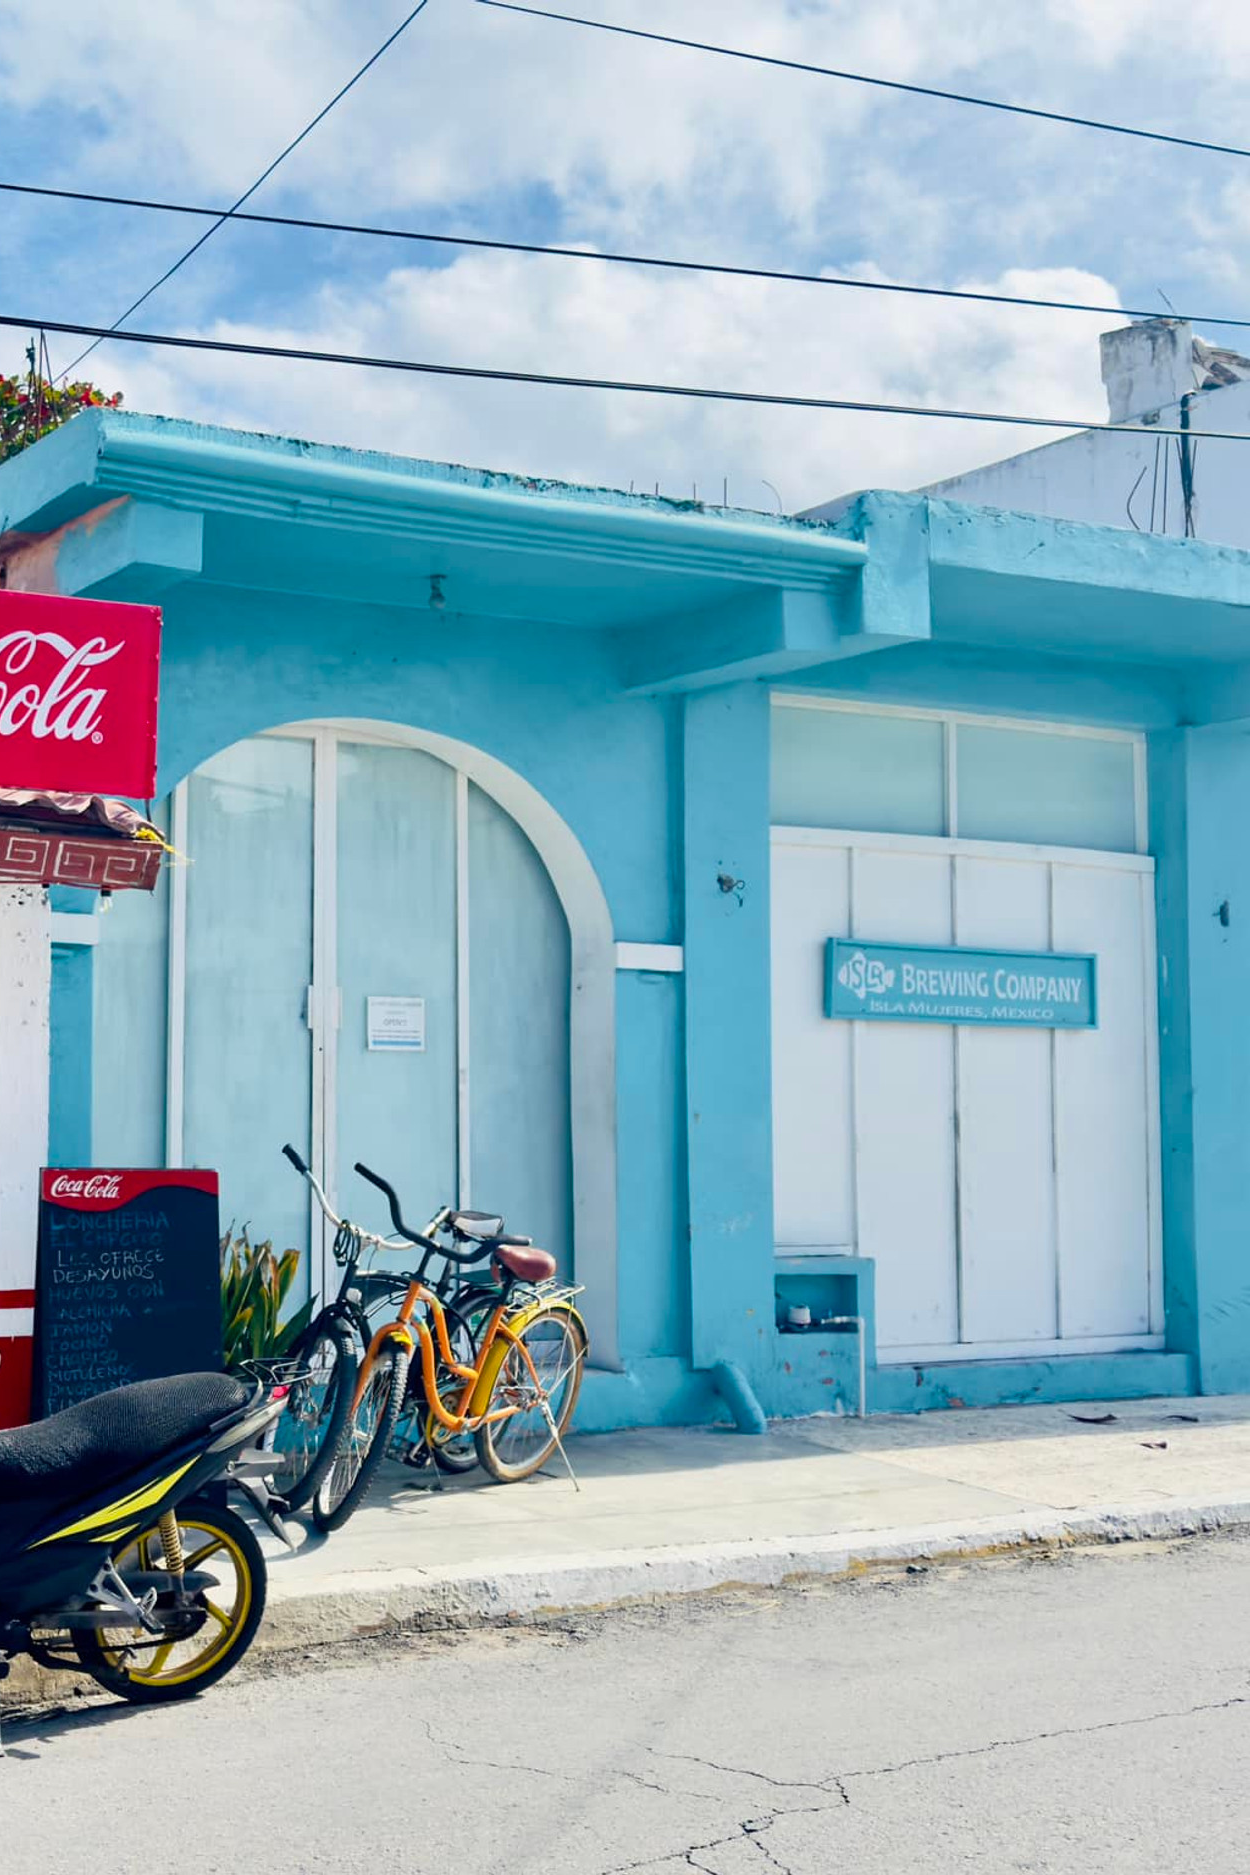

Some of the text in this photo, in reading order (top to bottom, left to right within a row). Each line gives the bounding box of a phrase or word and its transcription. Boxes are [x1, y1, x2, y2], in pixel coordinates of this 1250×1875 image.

[902, 962, 989, 998] BREWING
[994, 968, 1083, 1004] COMPANY
[870, 999, 905, 1014] ISLA
[50, 1174, 124, 1199] Coca-Cola
